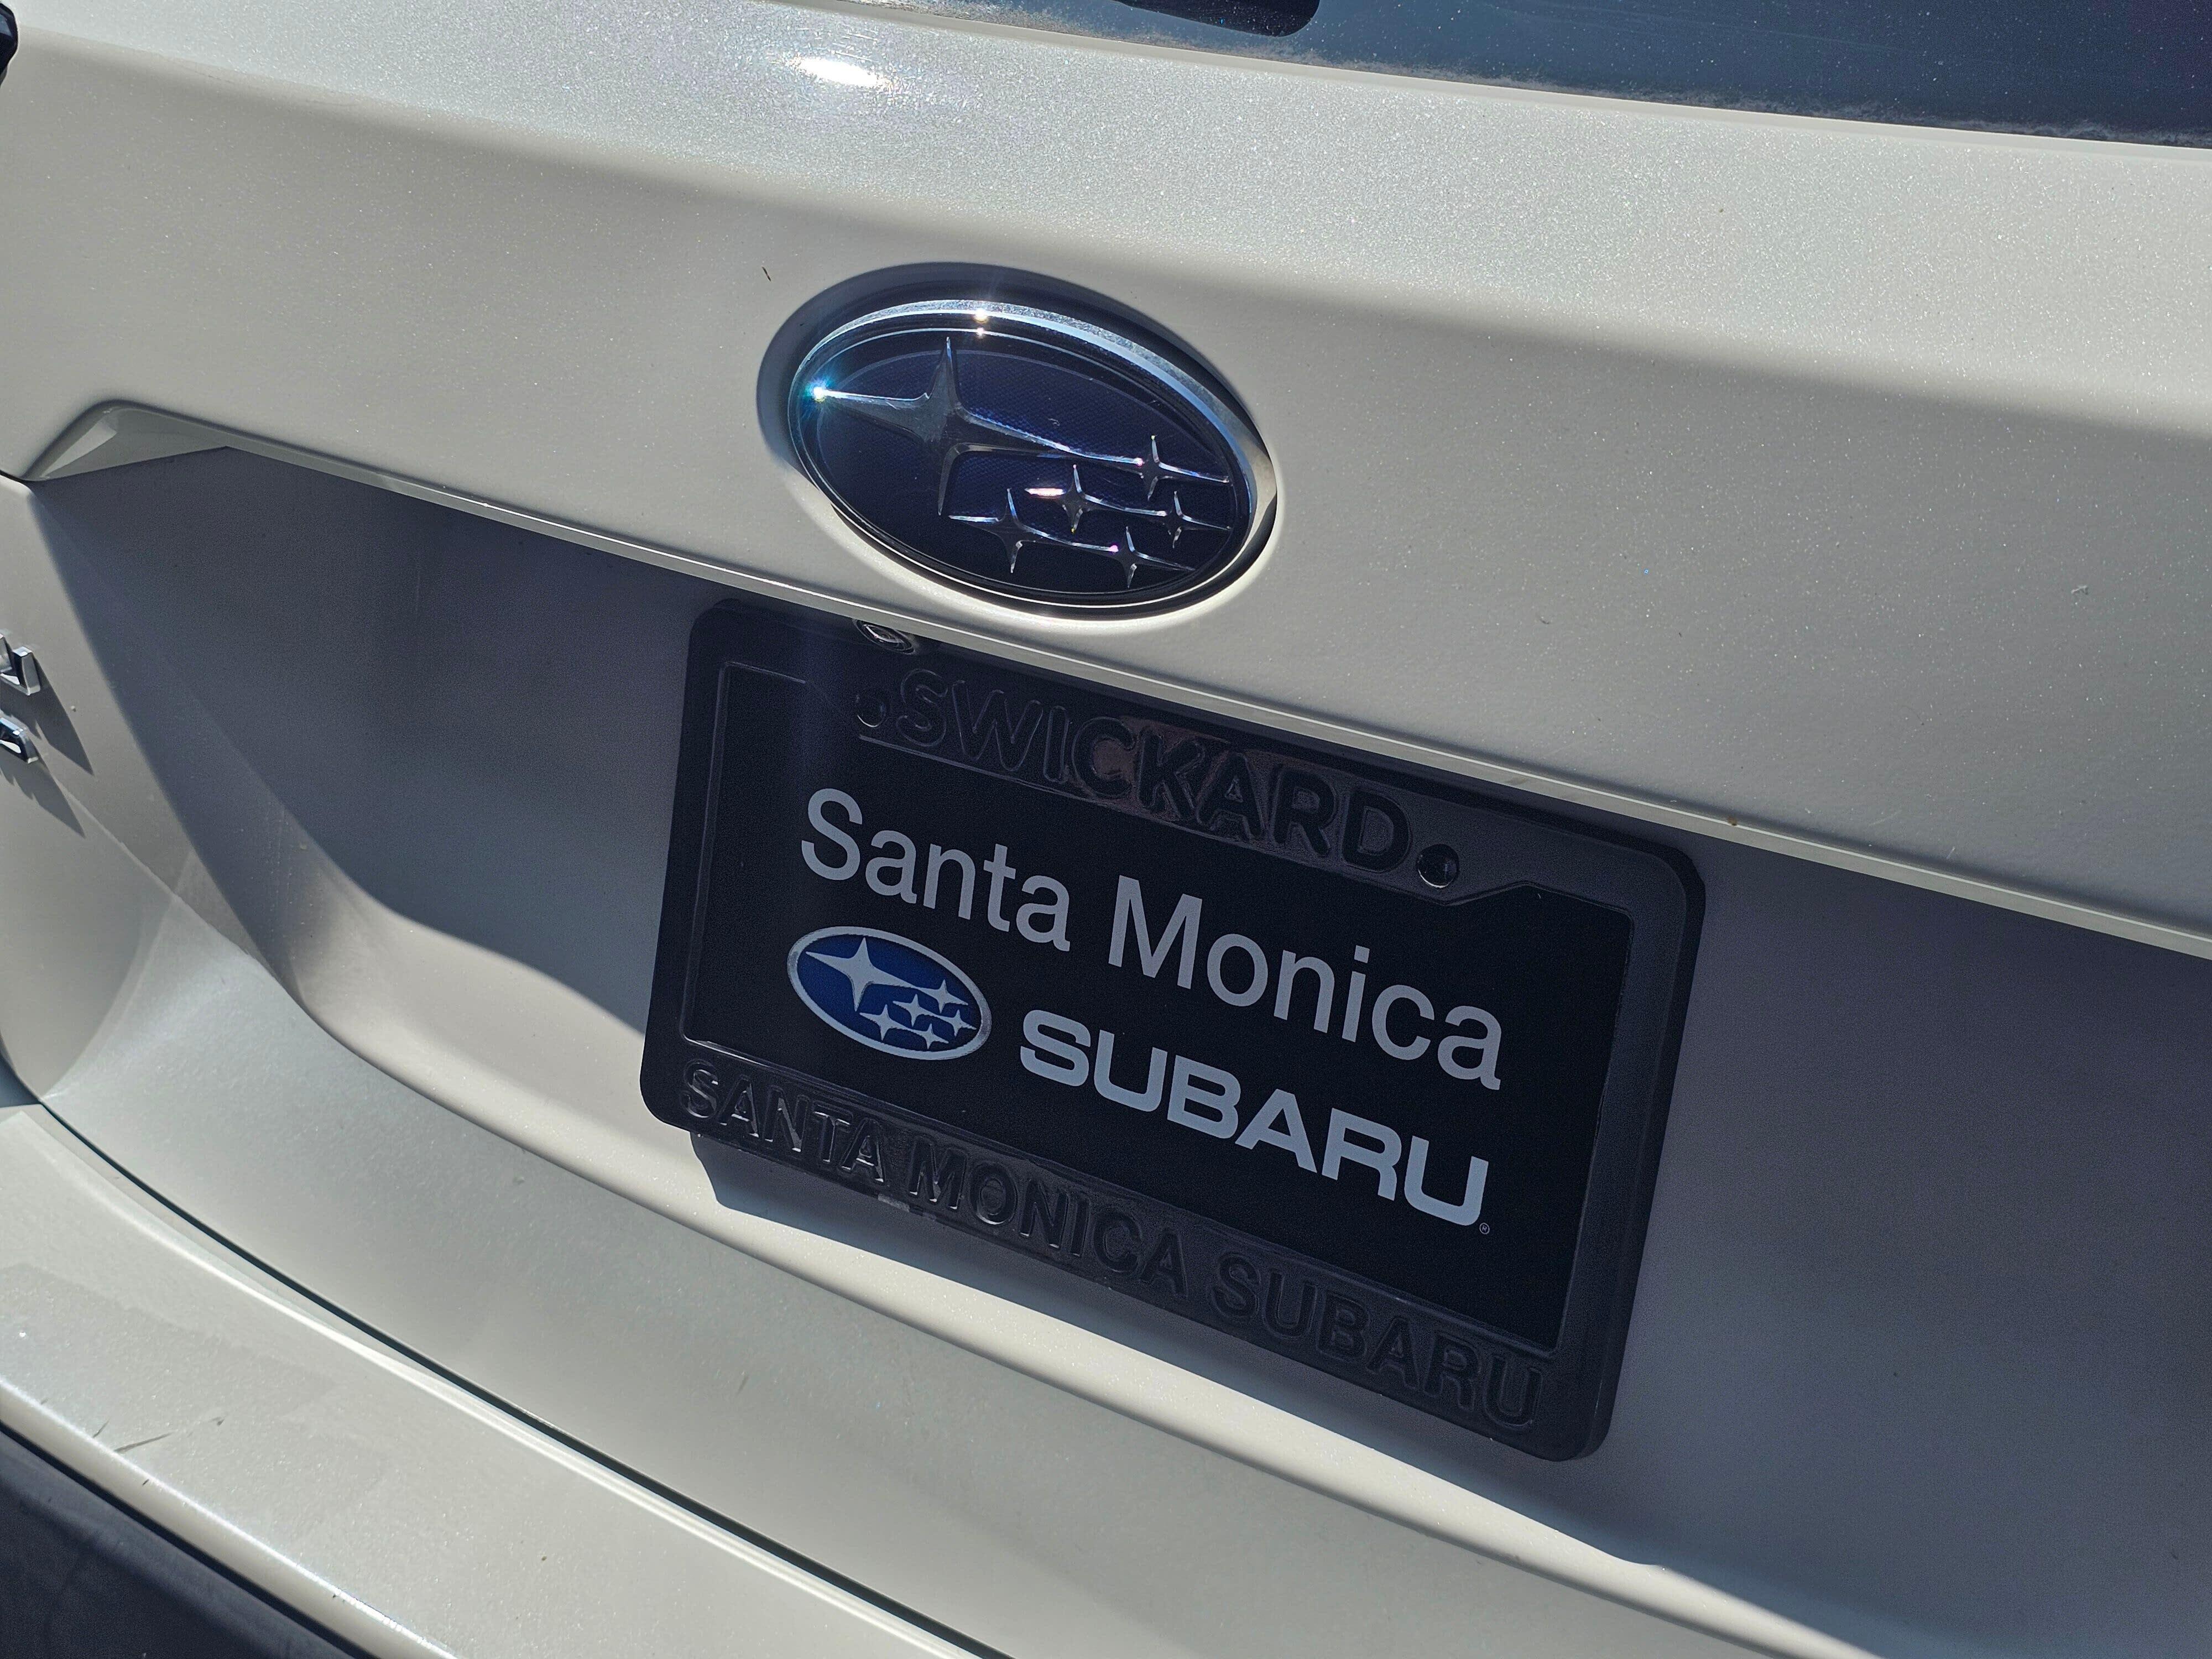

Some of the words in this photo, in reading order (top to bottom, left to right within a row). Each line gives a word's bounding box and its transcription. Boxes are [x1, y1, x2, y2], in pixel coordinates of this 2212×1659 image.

[895, 667, 1415, 874] SWICKARD
[801, 787, 1071, 952] Santa
[1108, 874, 1503, 1091] Monica
[678, 1058, 887, 1183] SANTA
[905, 1134, 1189, 1298] MONICA
[1211, 1250, 1544, 1429] SUBARU
[1019, 1009, 1490, 1227] SUBARU
